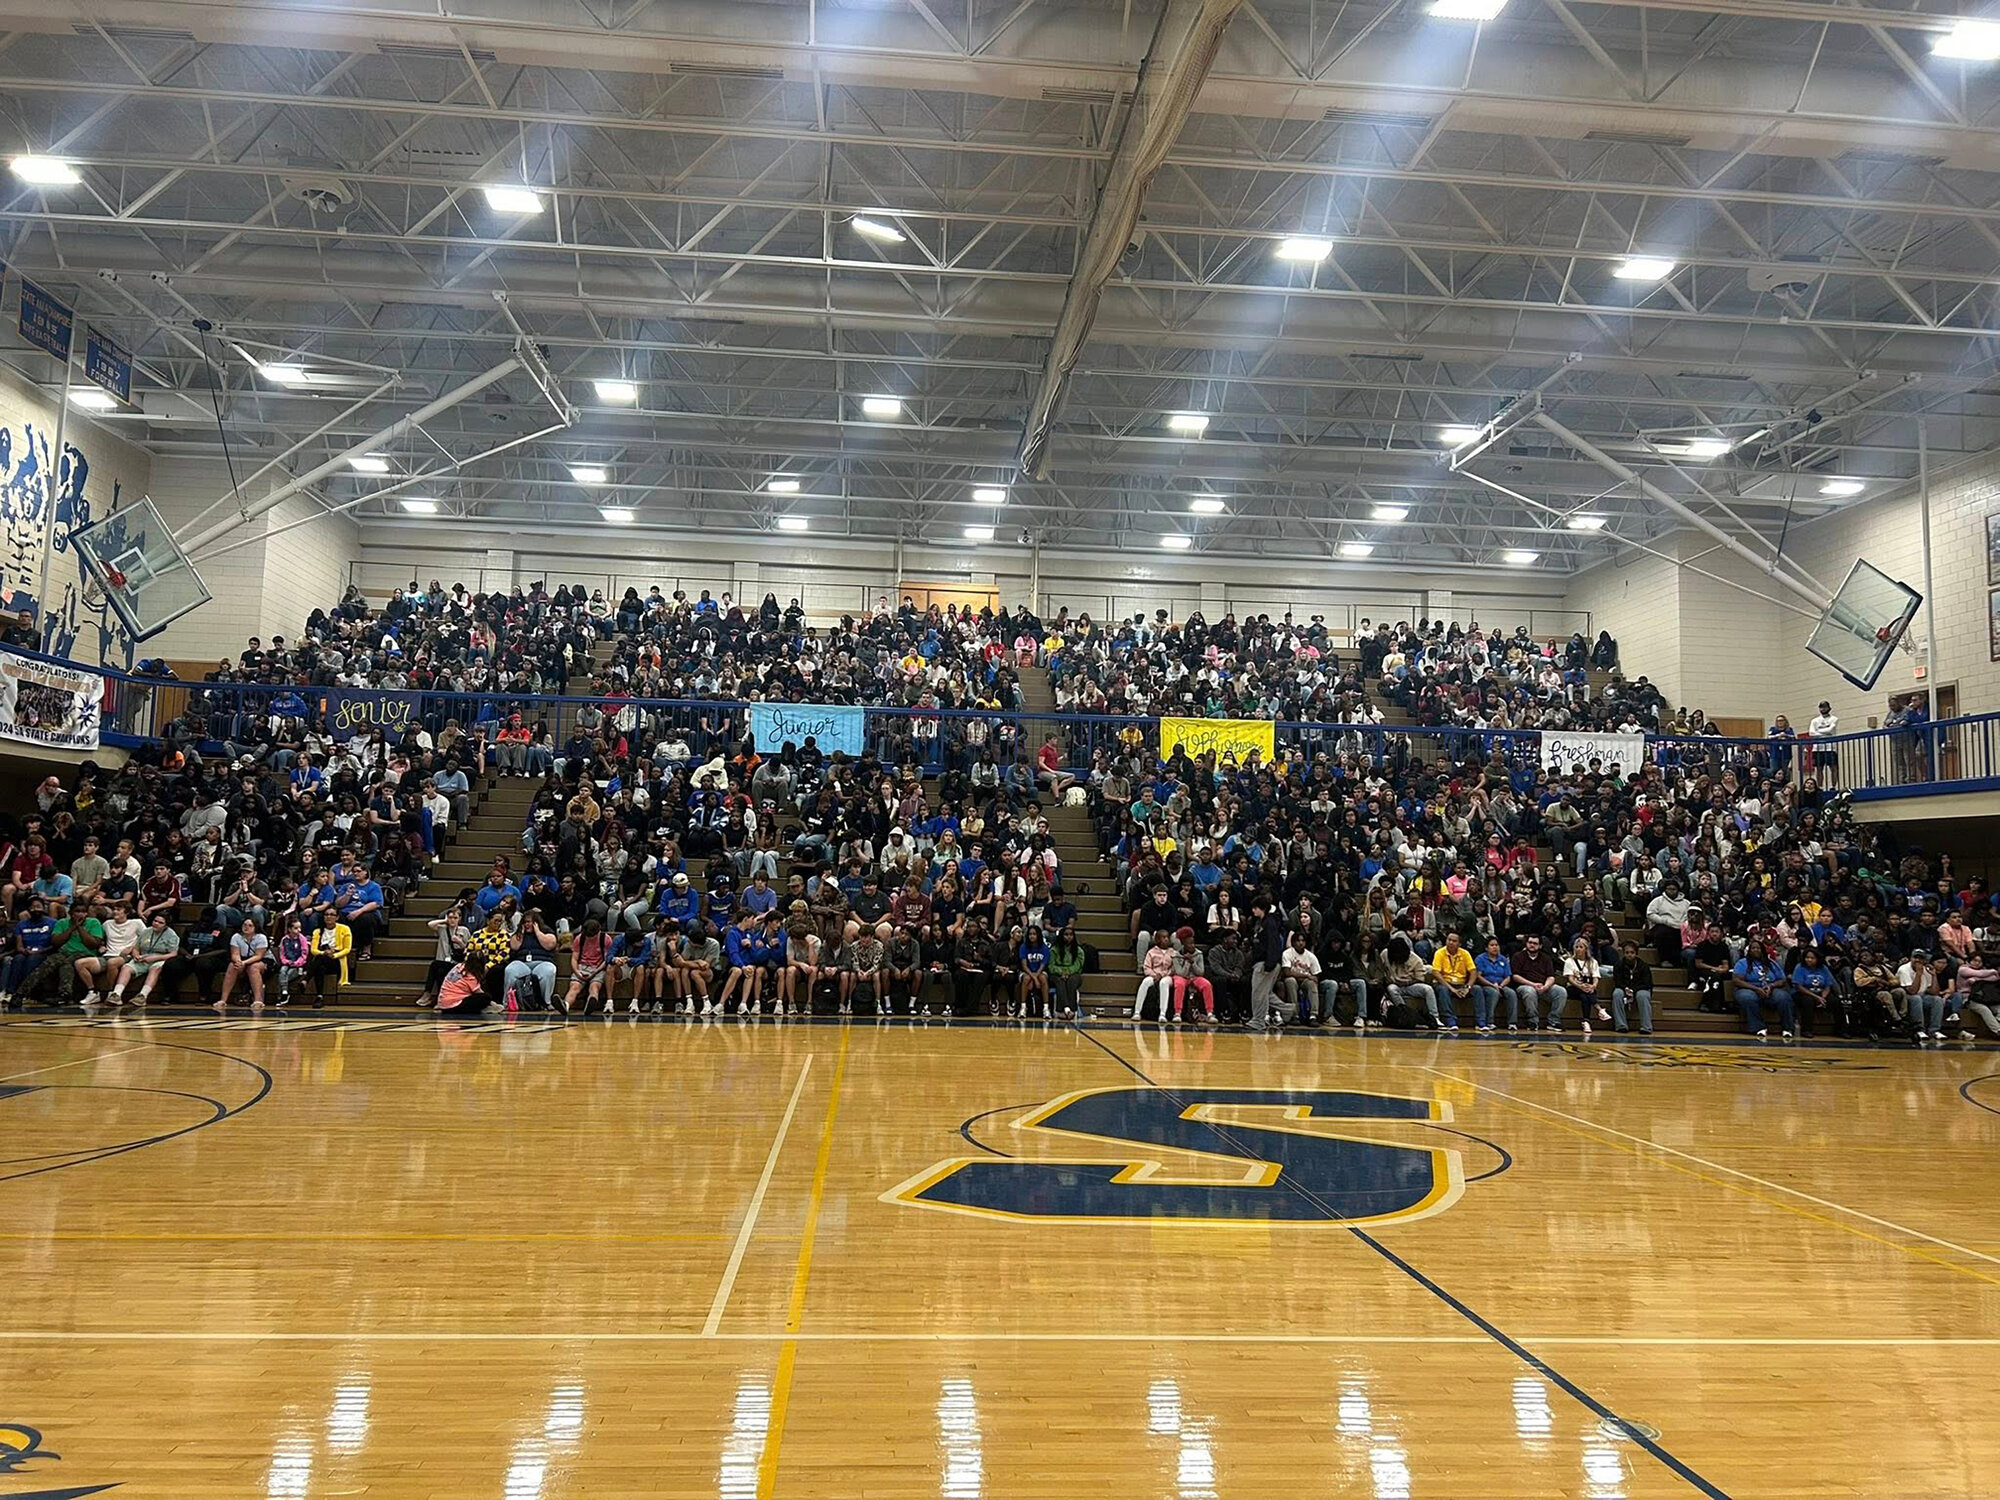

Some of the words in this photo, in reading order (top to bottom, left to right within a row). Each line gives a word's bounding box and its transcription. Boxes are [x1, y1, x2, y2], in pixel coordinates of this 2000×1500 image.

[91, 368, 124, 396] FOOTBALL
[25, 728, 49, 741] STATE
[768, 708, 841, 743] Junior
[877, 1085, 1466, 1229] S
